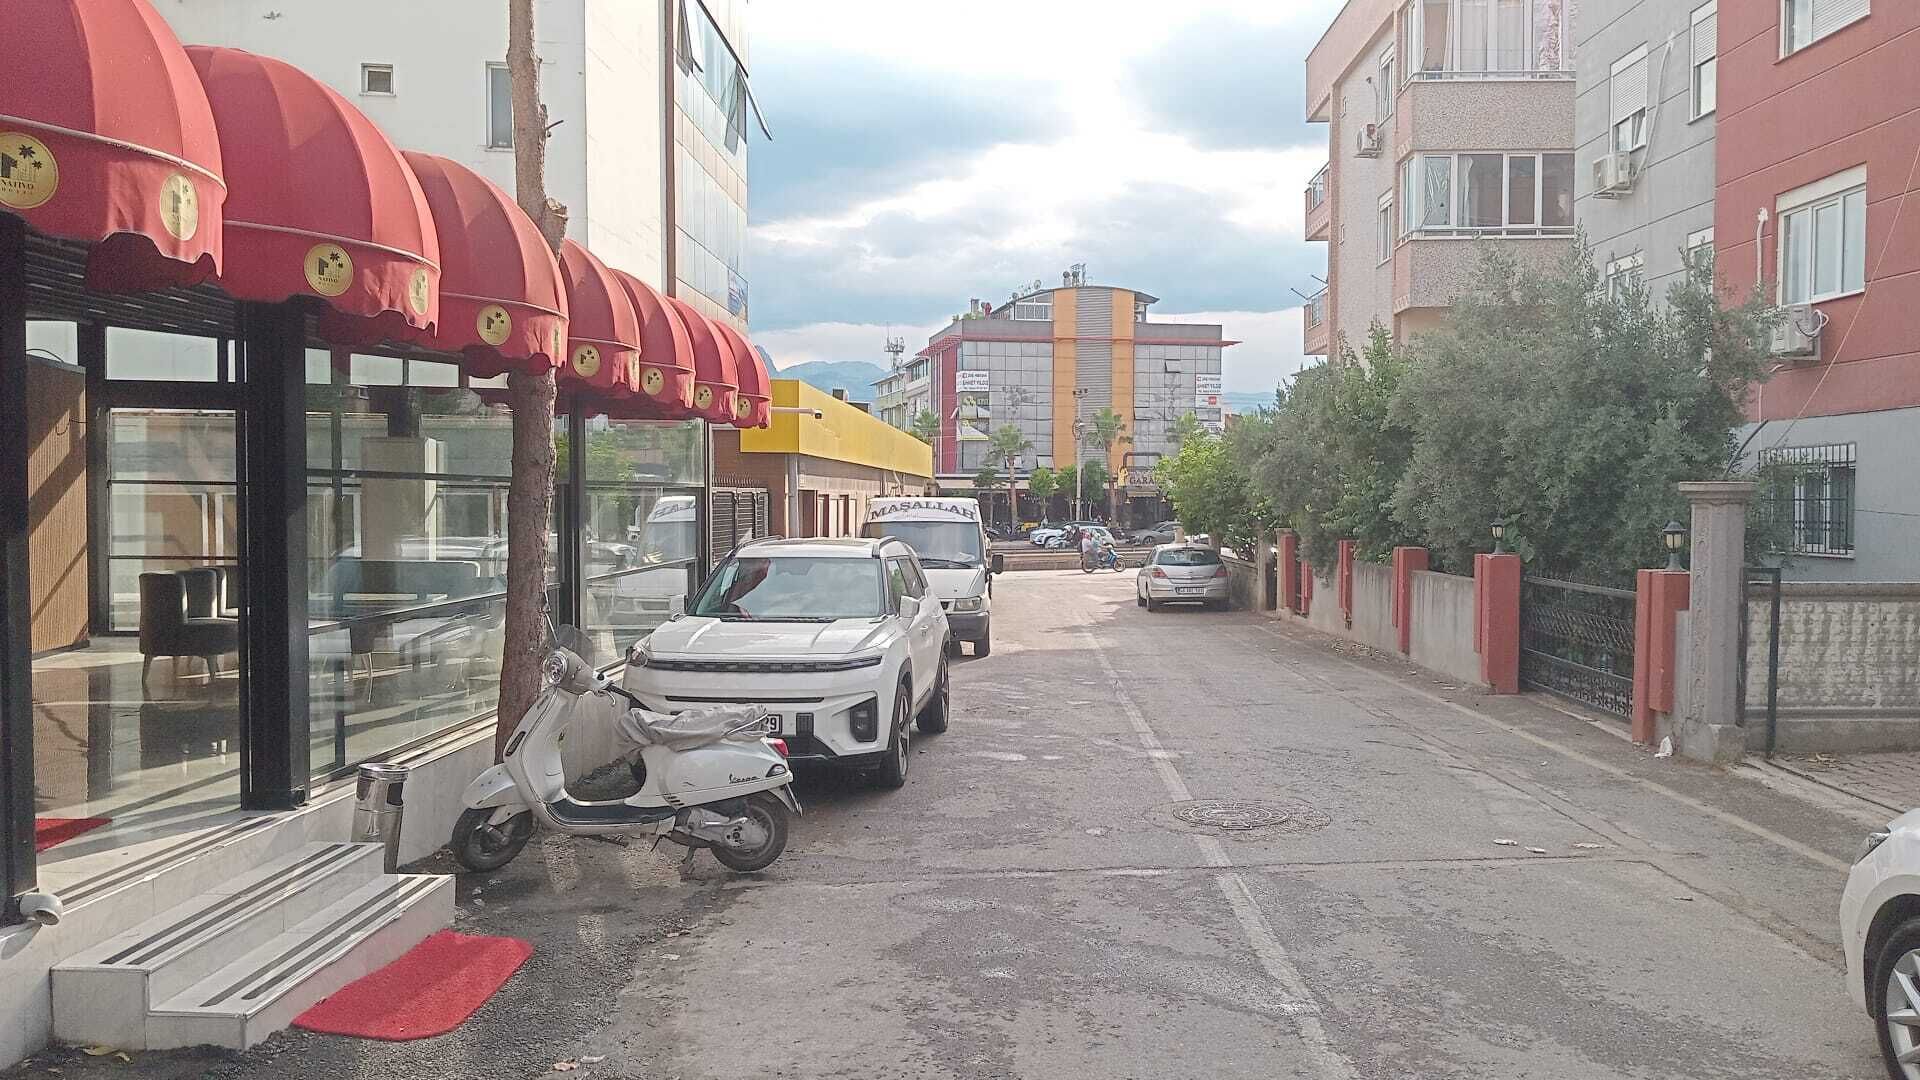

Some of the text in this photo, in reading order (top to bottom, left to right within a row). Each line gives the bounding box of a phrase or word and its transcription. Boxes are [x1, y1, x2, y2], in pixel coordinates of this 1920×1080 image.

[1, 179, 34, 190] NATIVO
[871, 501, 977, 521] MAŞALLAH
[729, 773, 760, 785] Vespa
